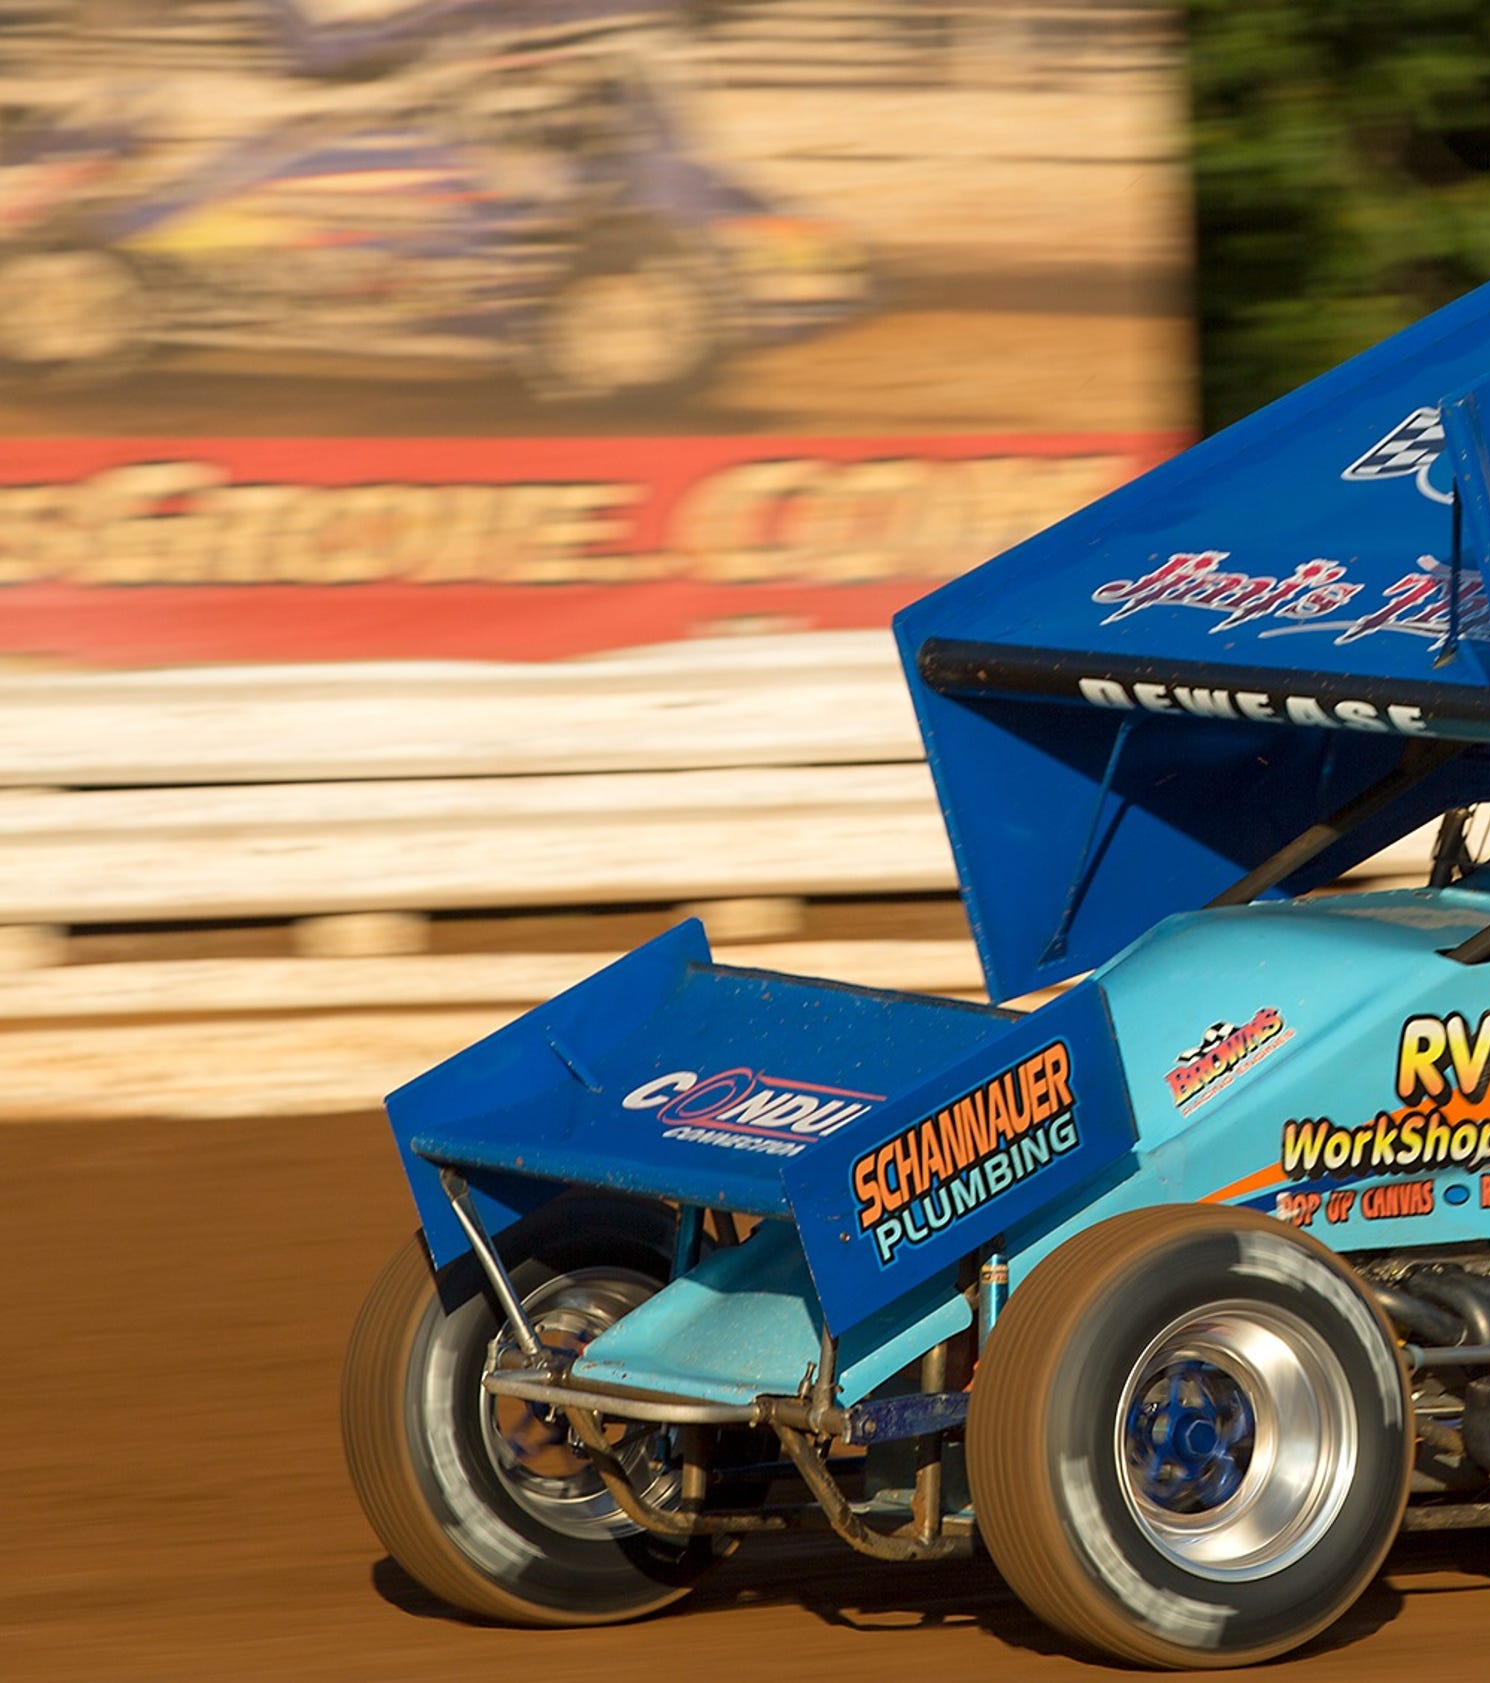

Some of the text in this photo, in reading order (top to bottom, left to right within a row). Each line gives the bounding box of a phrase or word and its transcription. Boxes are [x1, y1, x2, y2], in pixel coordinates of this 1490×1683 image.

[1078, 676, 1438, 737] DEWEASE
[662, 1125, 807, 1158] CONNECTION
[853, 1041, 1072, 1229] SCHANNAUER
[876, 1112, 1079, 1262] PLUMBING
[1326, 1190, 1355, 1223] UP
[1361, 1180, 1434, 1220] CANVAS
